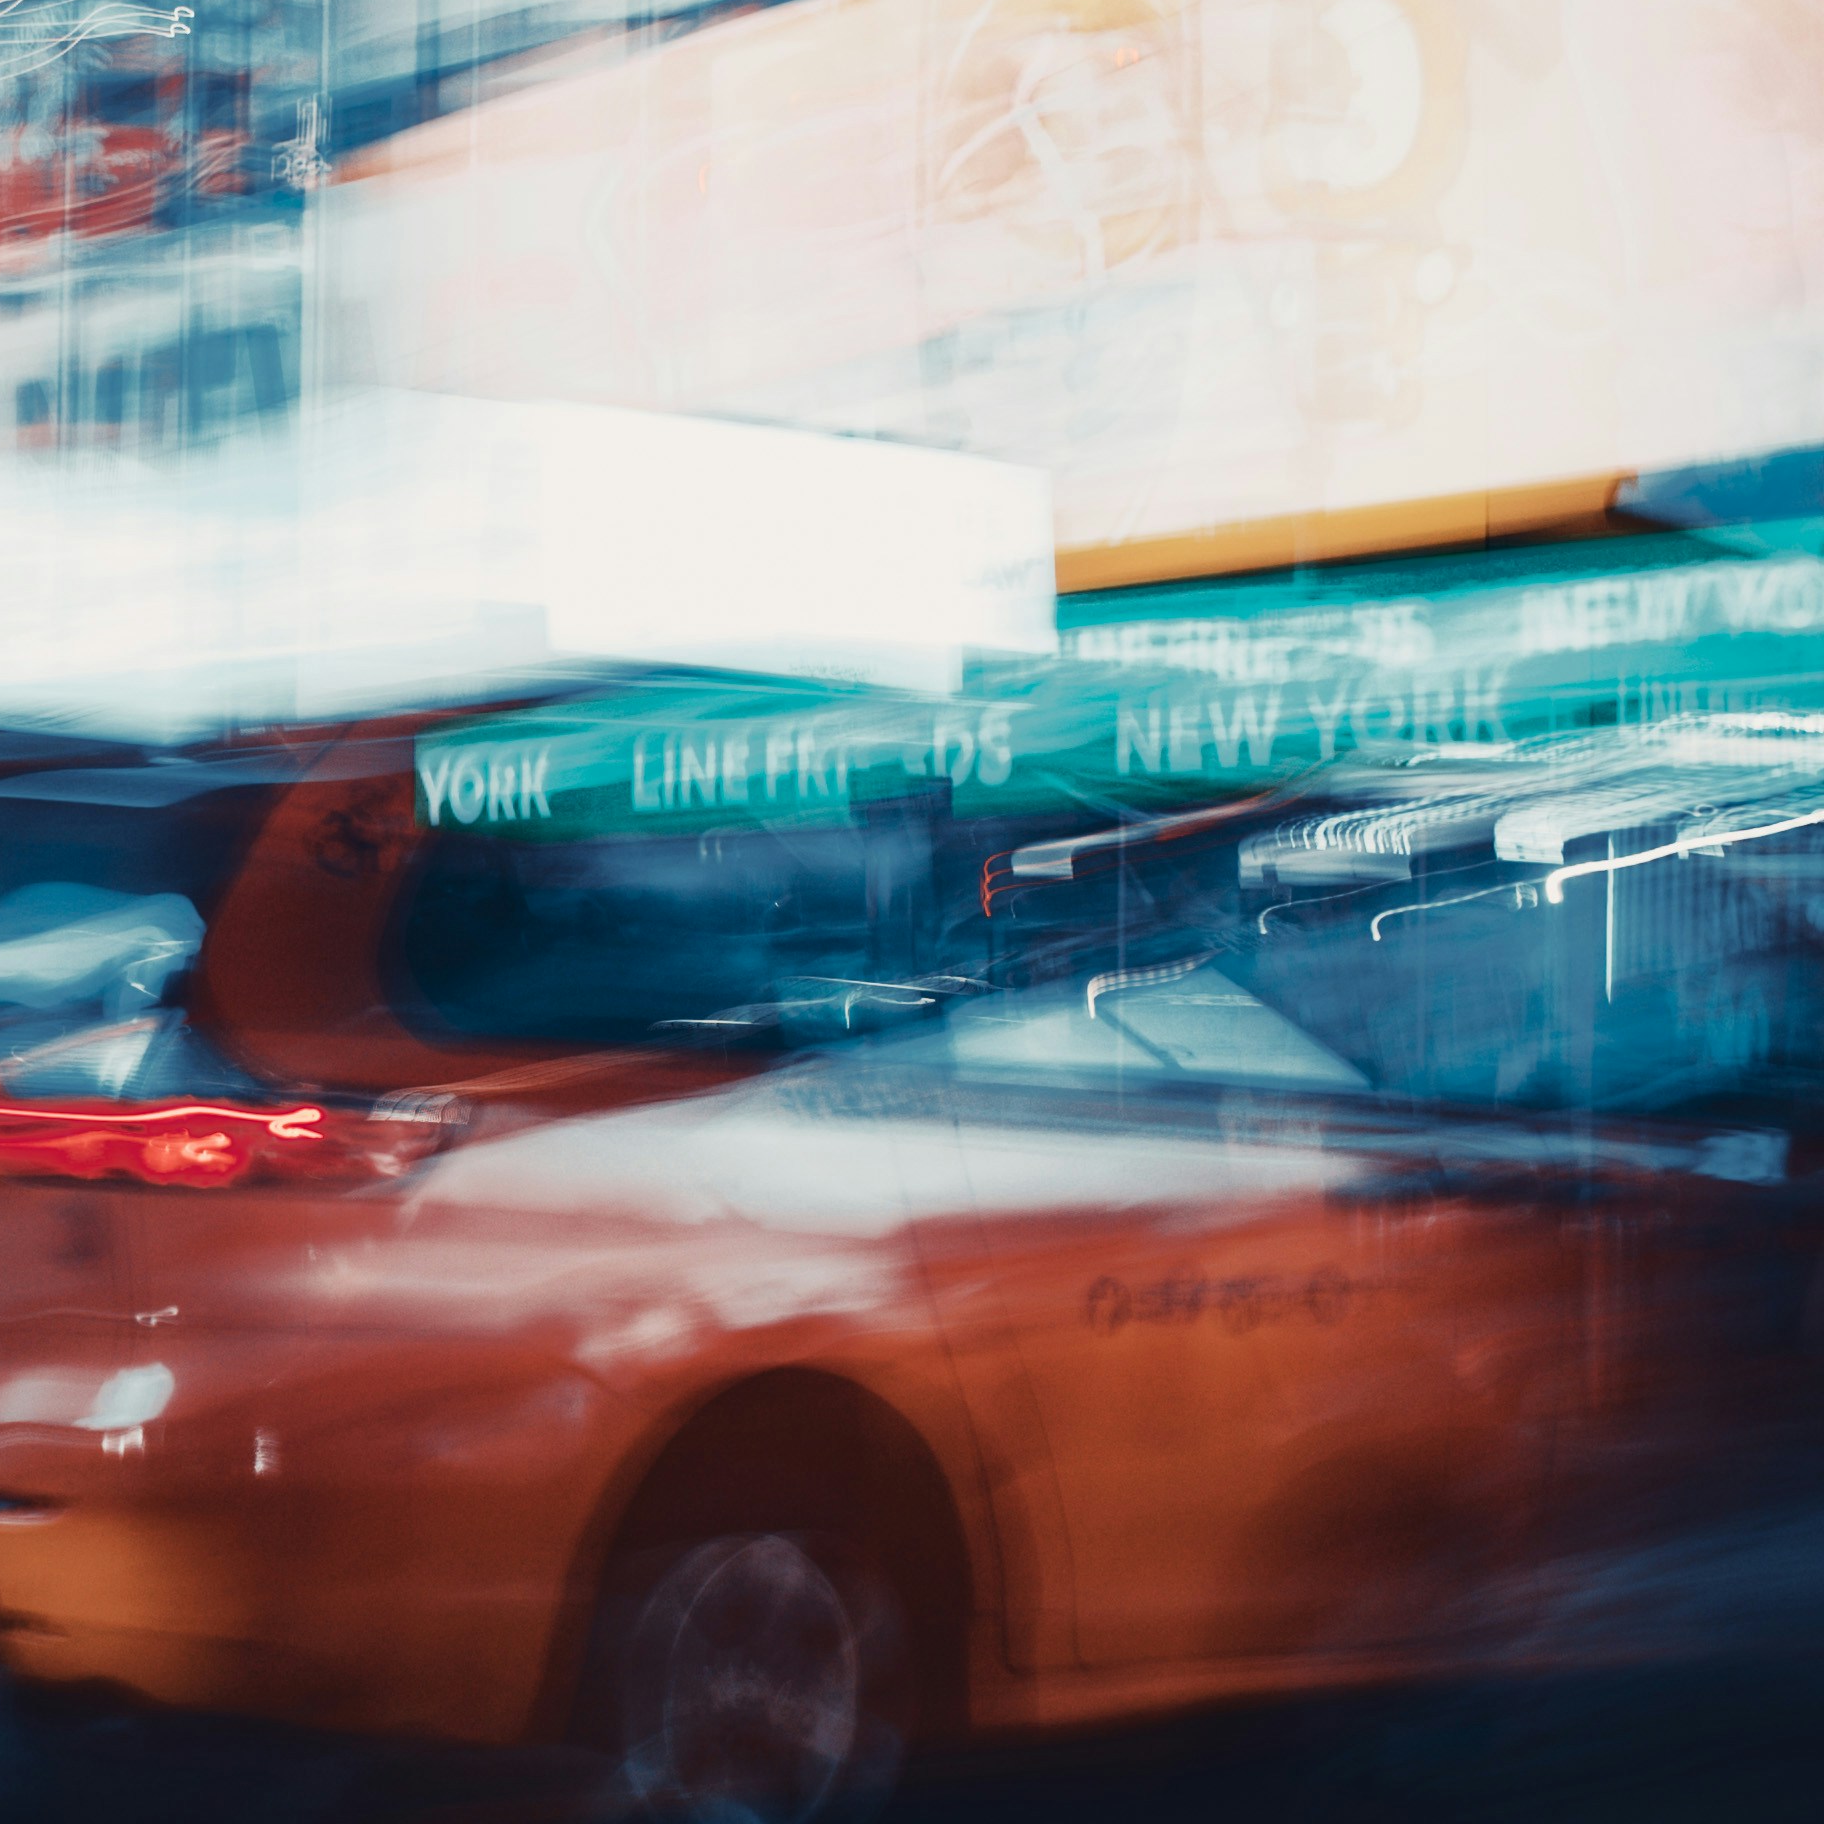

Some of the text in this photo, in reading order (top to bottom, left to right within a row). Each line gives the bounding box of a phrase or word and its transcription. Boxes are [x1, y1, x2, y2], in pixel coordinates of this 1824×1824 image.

[418, 742, 552, 826] YORK
[632, 732, 750, 811] LINE
[1116, 682, 1280, 774] NEW
[1304, 668, 1512, 761] YORK
